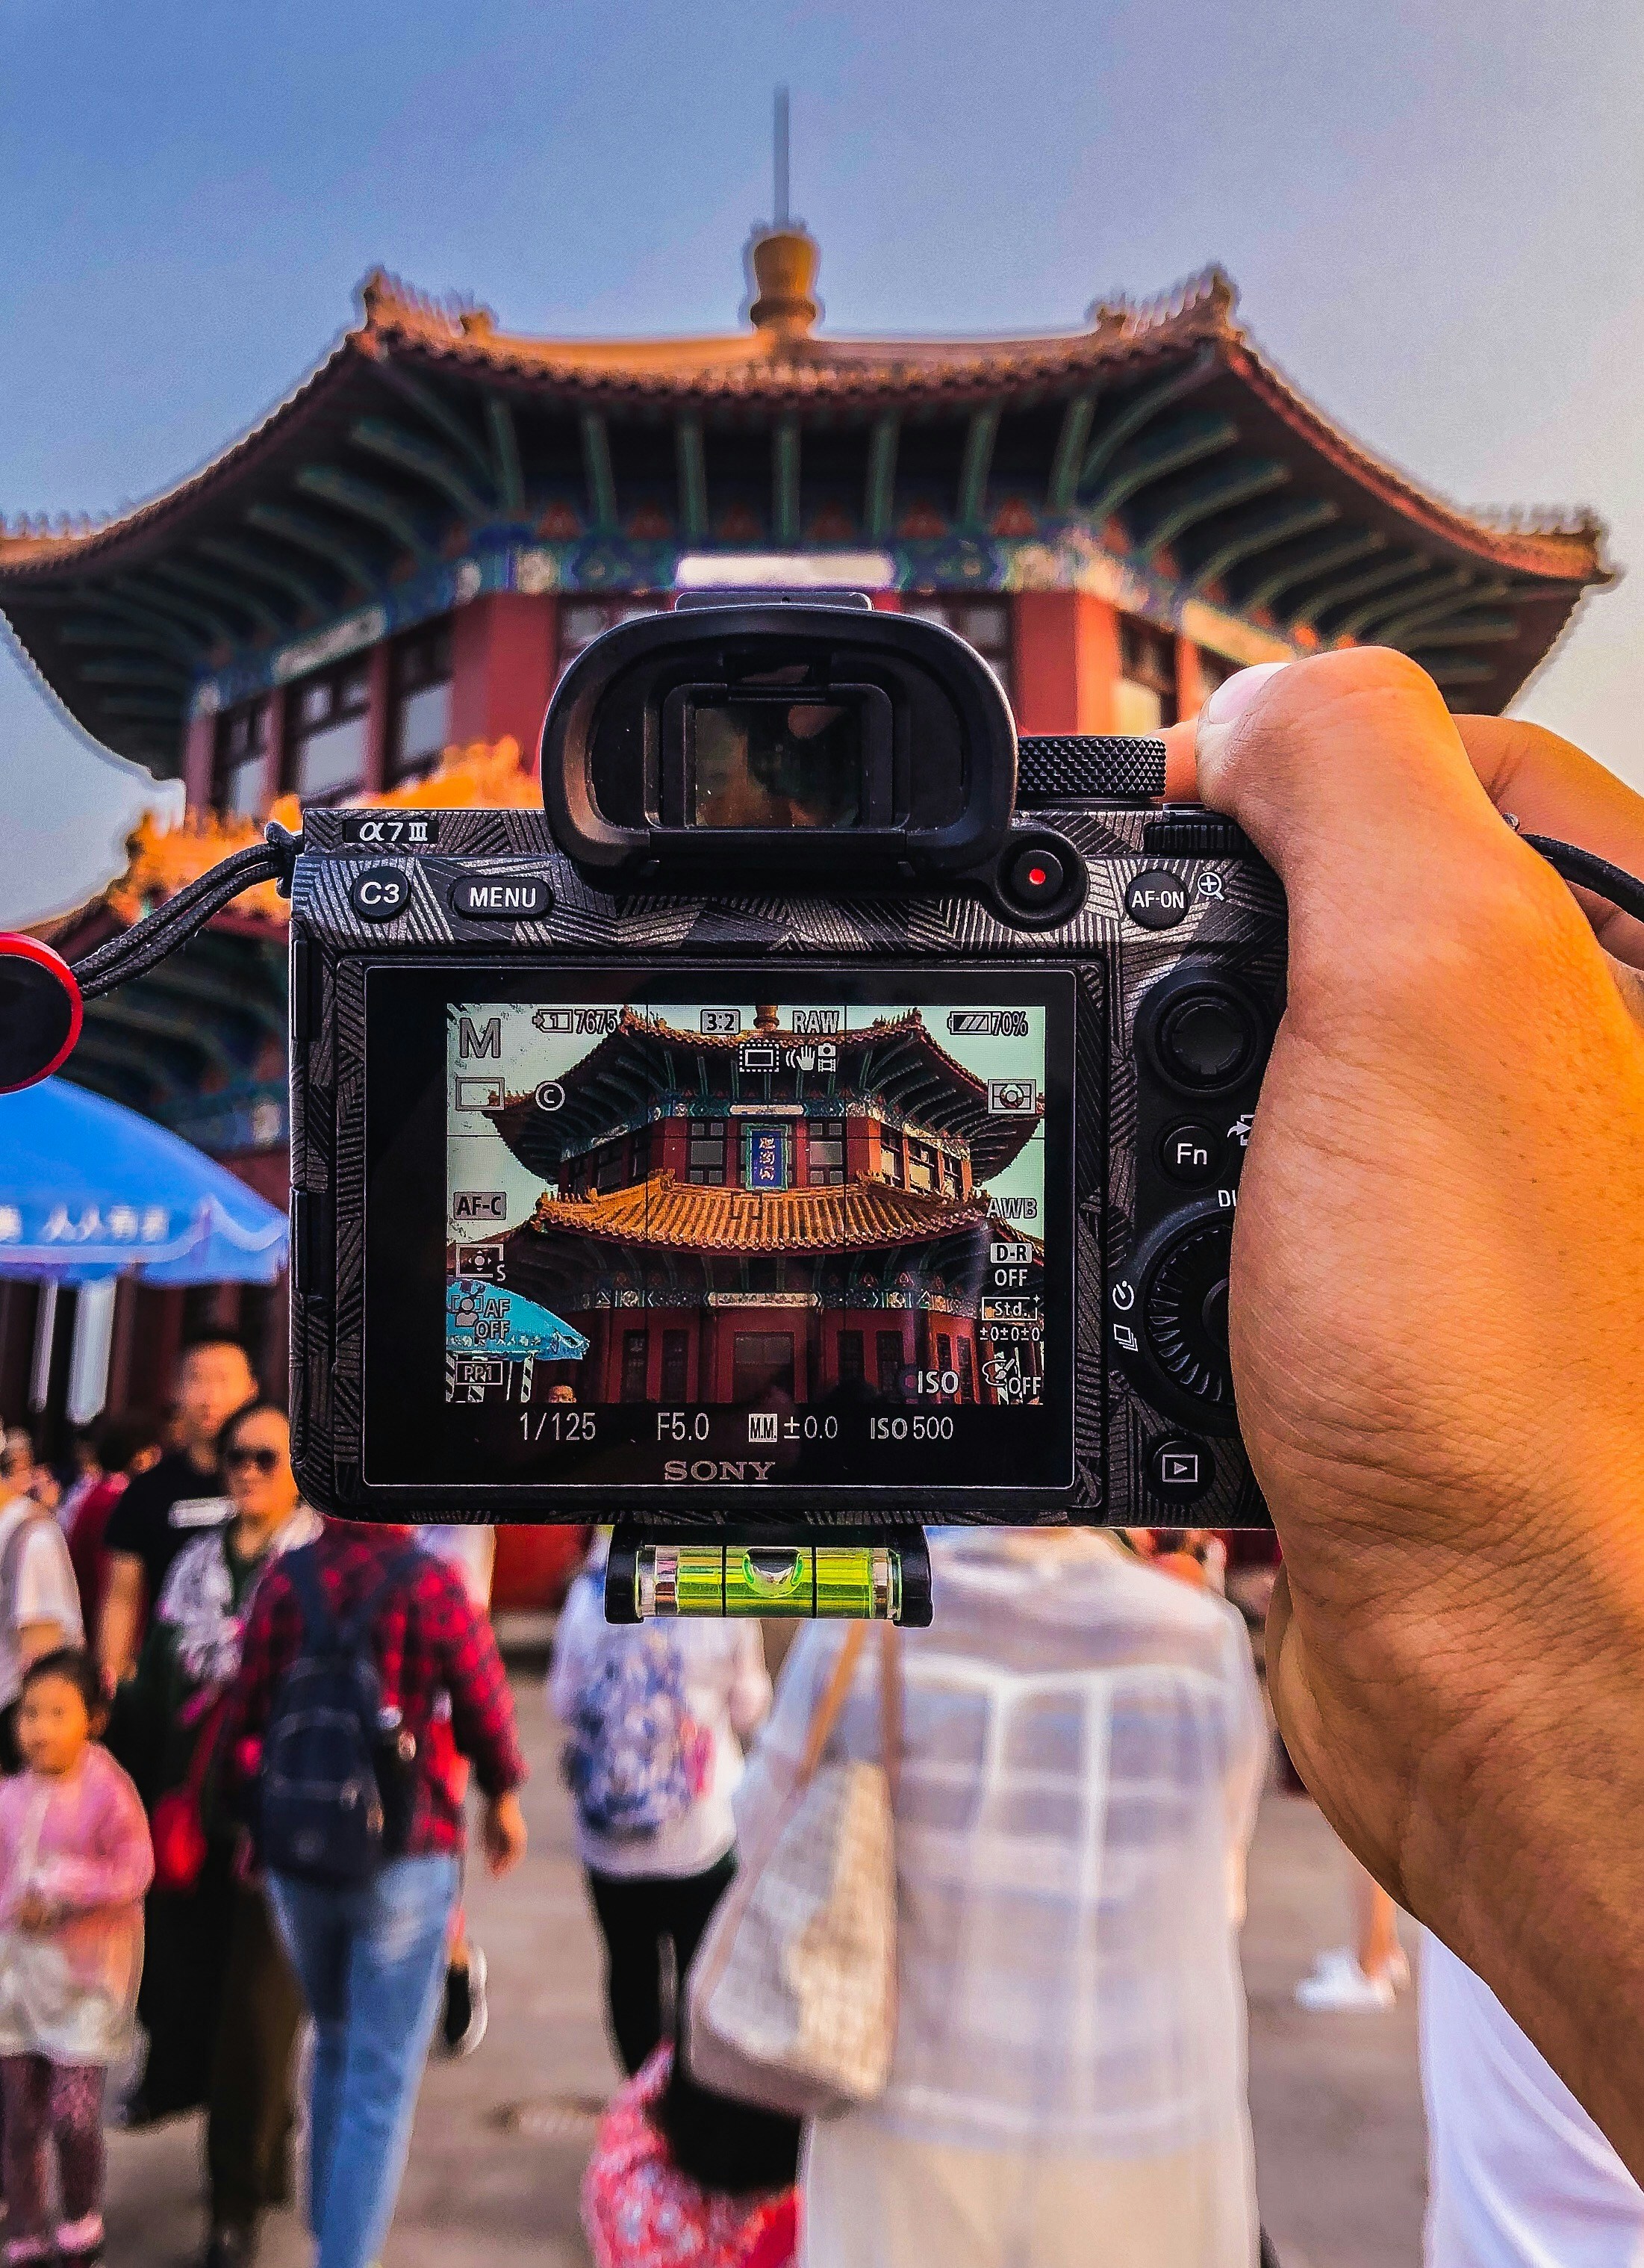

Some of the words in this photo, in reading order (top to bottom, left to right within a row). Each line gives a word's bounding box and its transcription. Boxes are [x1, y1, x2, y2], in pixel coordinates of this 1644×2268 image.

[361, 881, 399, 904] C3
[469, 886, 537, 908] MENU
[1132, 890, 1185, 909] AF-ON
[574, 1009, 618, 1034] 7675
[706, 1012, 735, 1031] 3:2
[792, 1010, 839, 1034] RAW
[991, 1011, 1028, 1036] 70%
[459, 1017, 501, 1058] M
[1177, 1144, 1207, 1165] Fn
[456, 1196, 502, 1215] AF-C
[986, 1198, 1037, 1219] AWB
[1218, 1190, 1236, 1207] DI
[997, 1245, 1027, 1261] D-R
[994, 1269, 1028, 1287] OFF
[485, 1299, 511, 1318] AF
[994, 1302, 1028, 1317] Std.
[474, 1320, 511, 1339] OFF
[917, 1370, 959, 1394] ISO
[1009, 1376, 1041, 1395] OFF
[520, 1412, 596, 1441] 1/125
[657, 1412, 709, 1441] F5.0
[784, 1416, 838, 1439] ±0.0
[871, 1417, 908, 1440] ISO
[913, 1416, 953, 1440] 500
[664, 1461, 776, 1481] SONY
